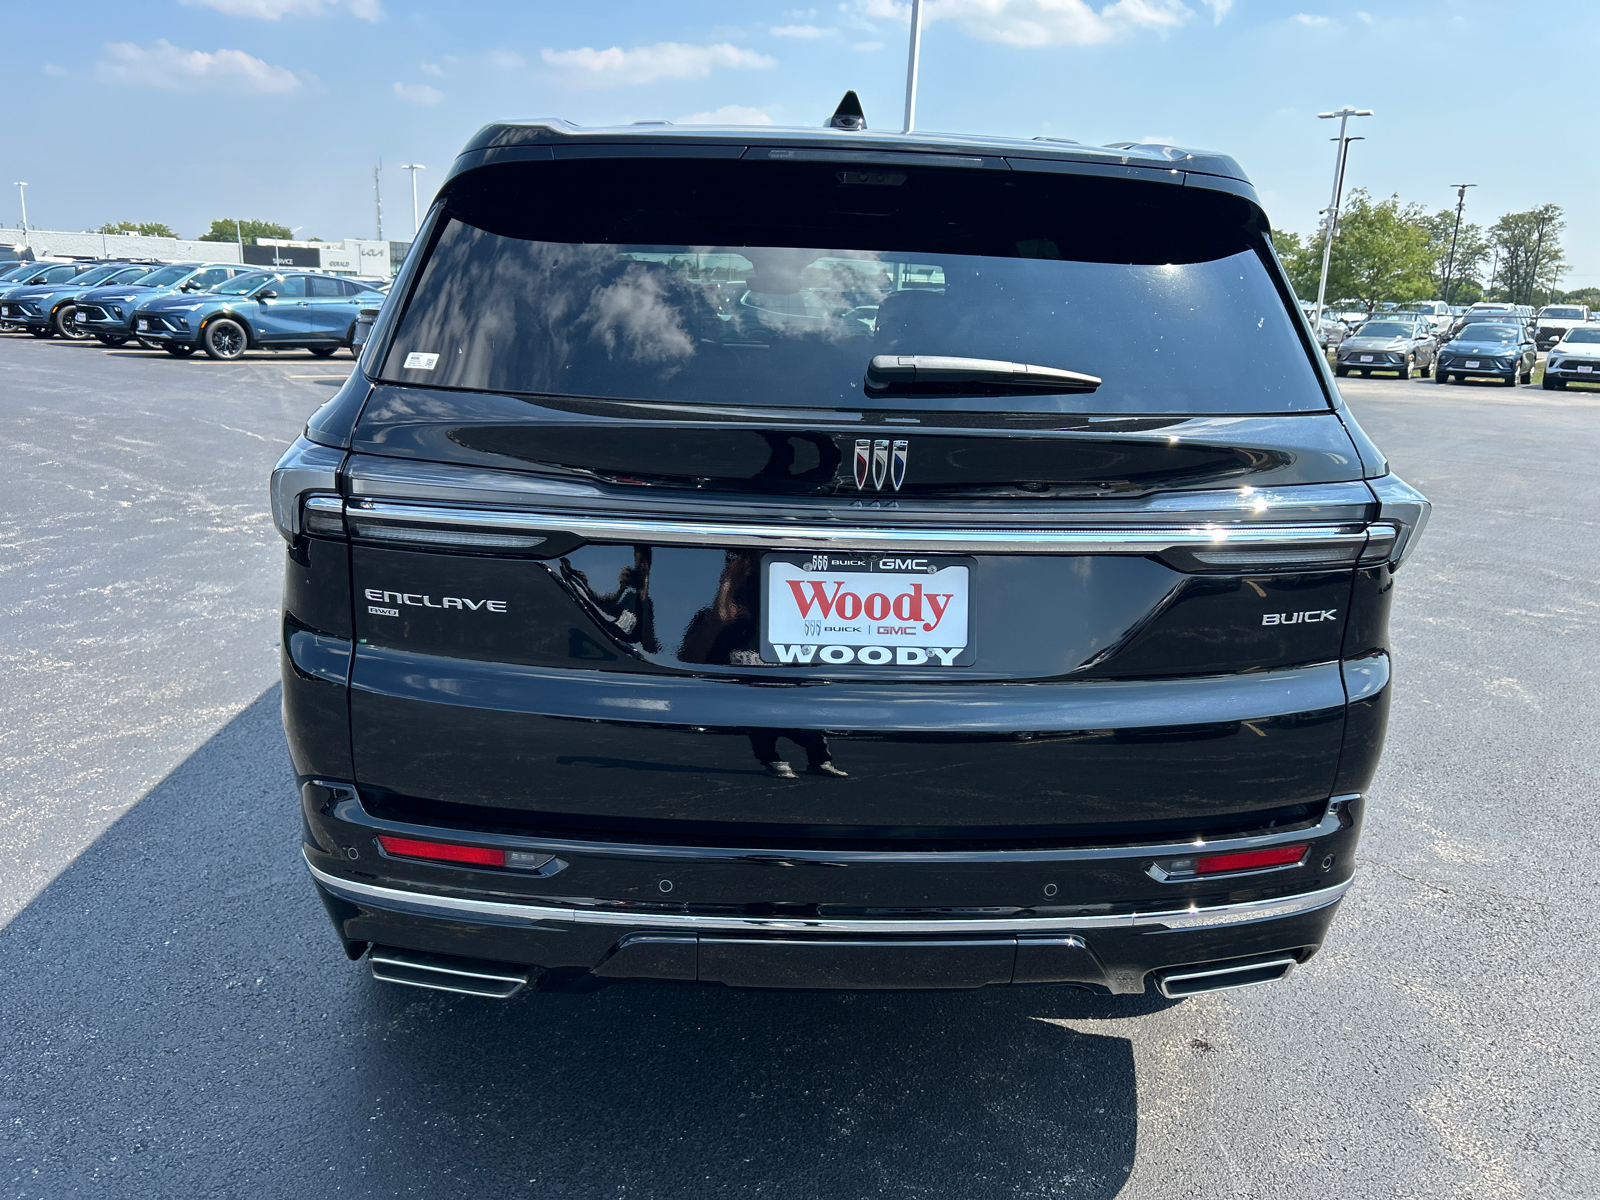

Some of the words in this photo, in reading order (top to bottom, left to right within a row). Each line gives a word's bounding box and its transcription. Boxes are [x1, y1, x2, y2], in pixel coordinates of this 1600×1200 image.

[879, 558, 928, 570] GMC
[364, 588, 508, 613] ENCLAVE
[785, 579, 954, 632] Woody
[369, 606, 398, 616] AWD
[1261, 608, 1337, 626] BUICK
[824, 625, 862, 633] BUICK
[876, 625, 917, 636] GMC
[772, 644, 965, 666] WOODY
